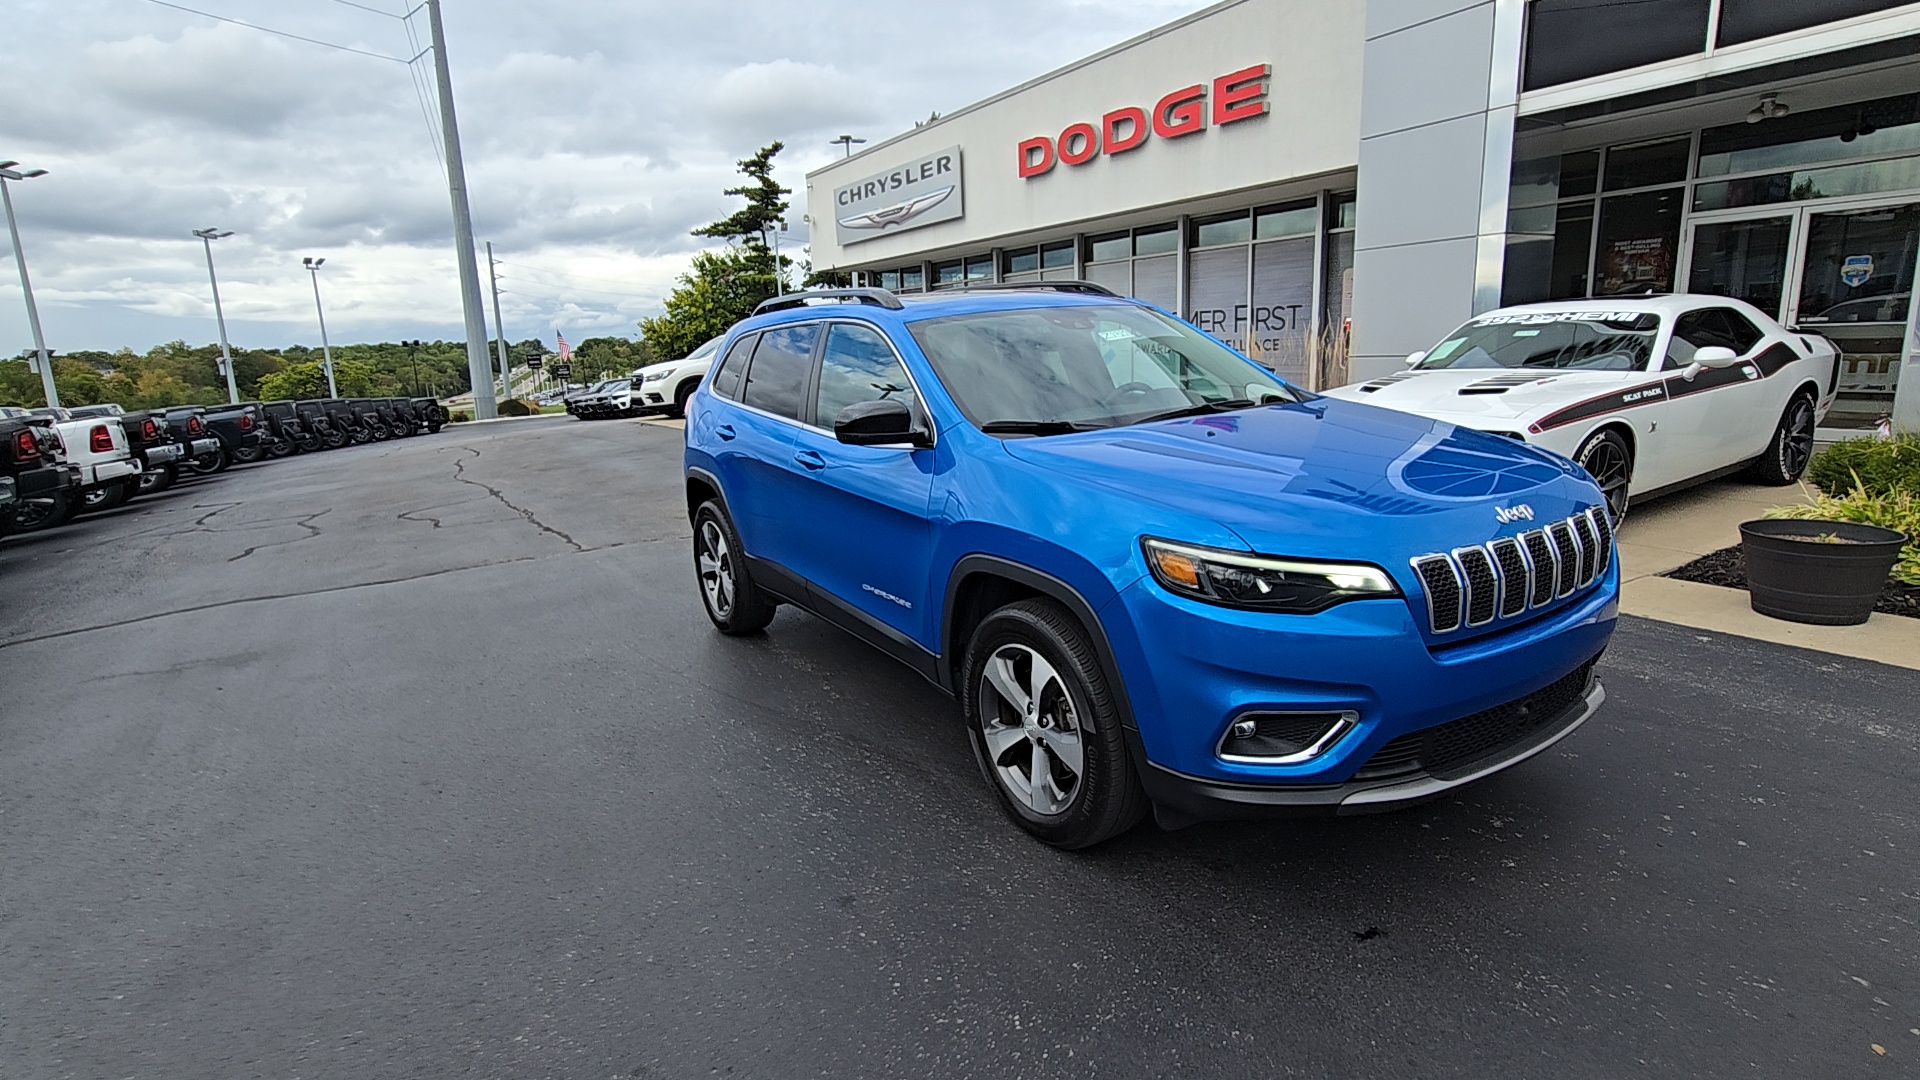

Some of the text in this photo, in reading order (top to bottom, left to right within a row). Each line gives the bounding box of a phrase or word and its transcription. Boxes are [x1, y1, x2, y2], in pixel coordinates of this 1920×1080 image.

[1018, 64, 1271, 179] DODGE
[838, 155, 952, 206] CHRYSLER
[1474, 312, 1640, 328] 392 HEMI
[1622, 387, 1663, 403] SCAT PACK
[1494, 503, 1535, 525] Jeep
[861, 583, 913, 609] CHEROKEE
